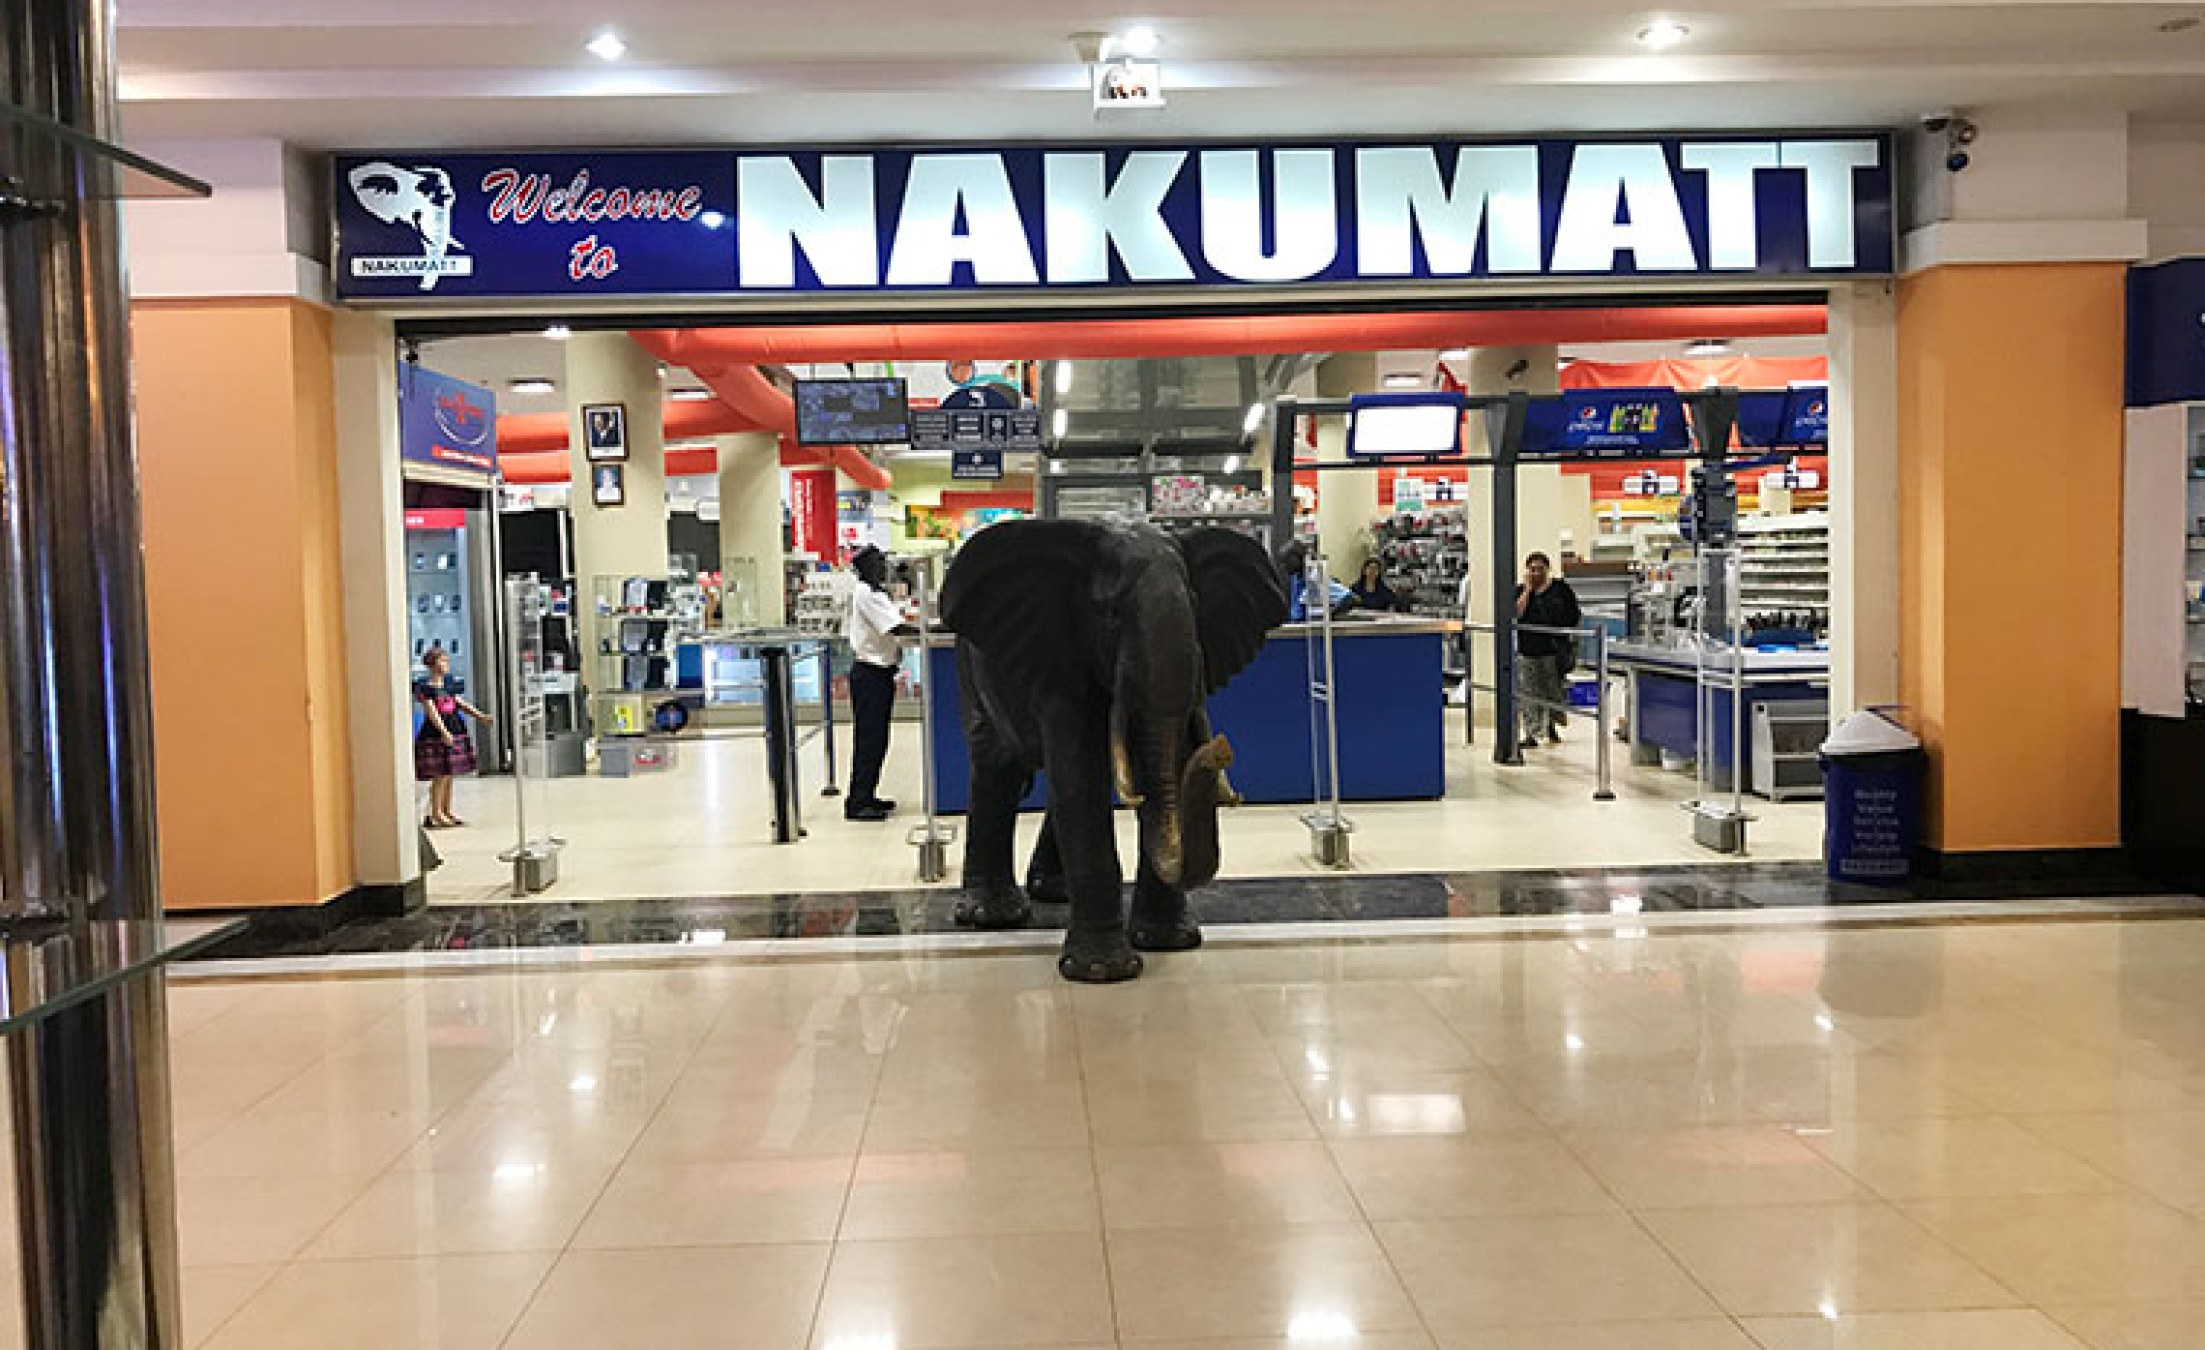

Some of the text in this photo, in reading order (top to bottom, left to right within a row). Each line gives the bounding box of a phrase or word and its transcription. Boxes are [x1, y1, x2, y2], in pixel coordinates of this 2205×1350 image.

[480, 168, 703, 224] Welcome
[737, 140, 1879, 288] NAKUMATT
[361, 259, 457, 274] NAKUMATT
[567, 234, 619, 281] to
